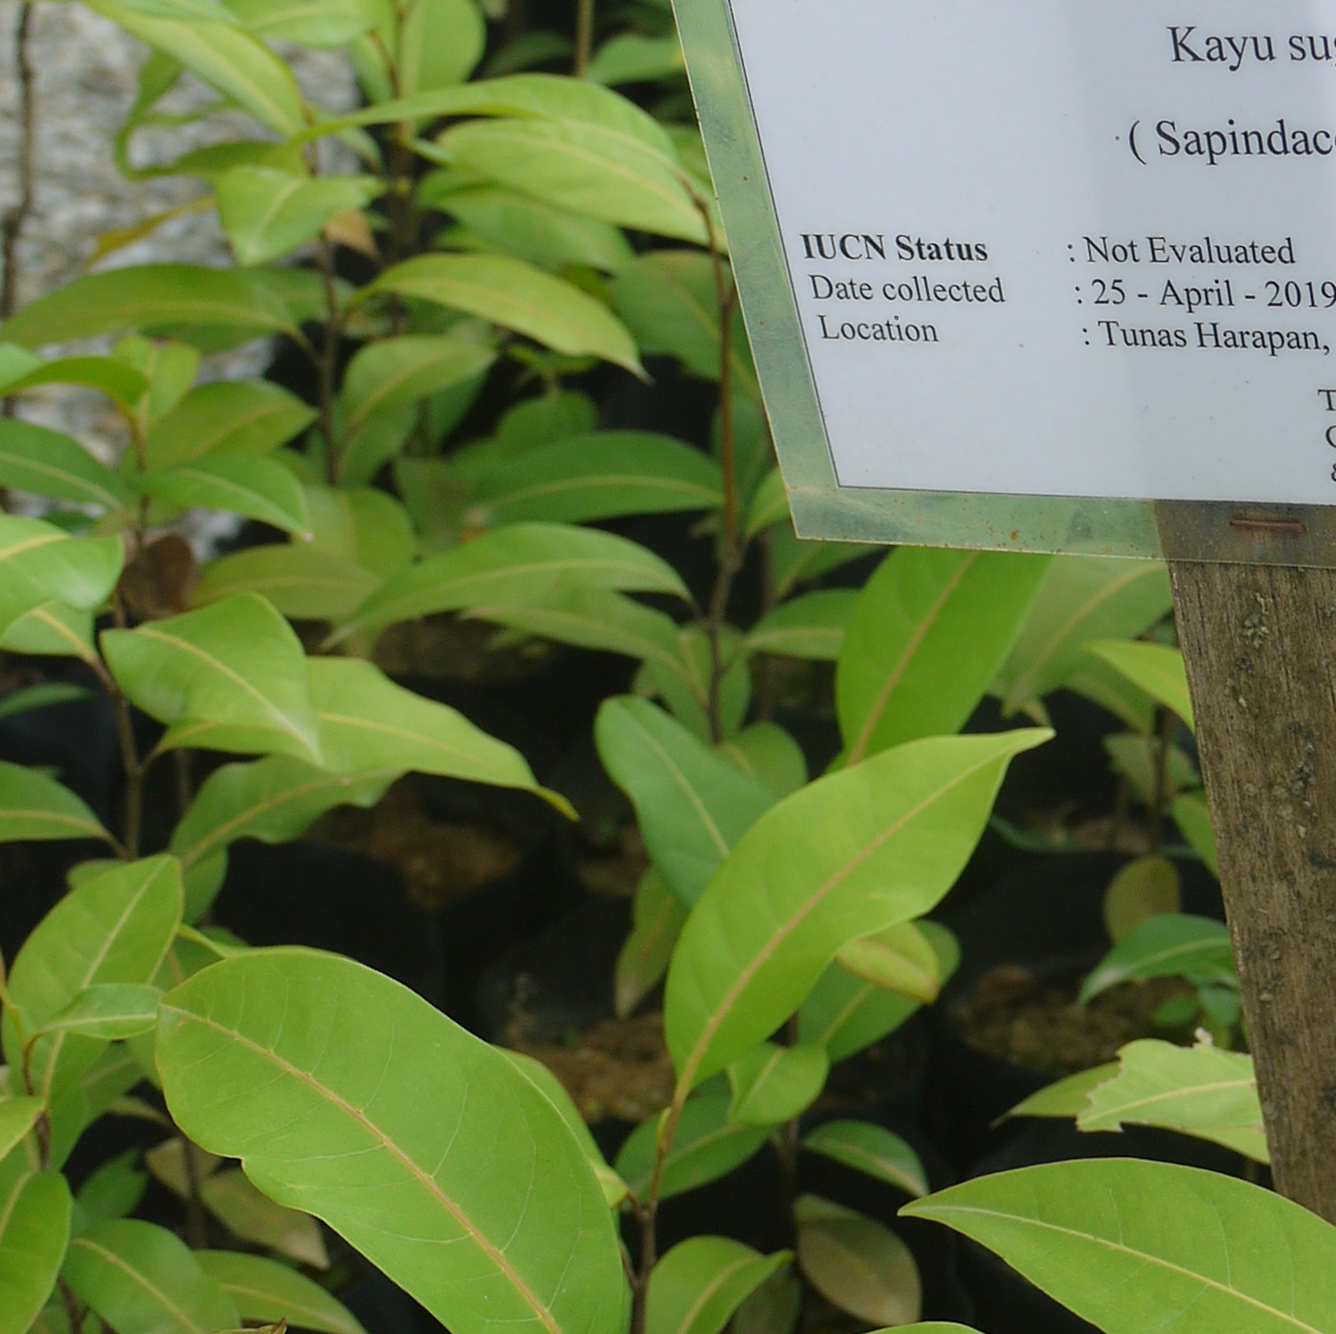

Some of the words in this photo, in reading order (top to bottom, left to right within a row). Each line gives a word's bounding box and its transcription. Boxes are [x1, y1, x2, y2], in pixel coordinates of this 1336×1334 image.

[1166, 25, 1277, 72] Kayu
[799, 233, 887, 261] IUCN
[895, 234, 989, 262] Status
[1081, 236, 1141, 264] Not
[1148, 236, 1297, 266] Evaluated
[808, 273, 874, 302] Date
[881, 275, 1006, 303] collected
[1091, 278, 1126, 305] 25
[1159, 278, 1236, 314] April
[816, 314, 940, 343] Location
[1097, 320, 1188, 348] Tunas
[1193, 321, 1331, 357] Harapan,
